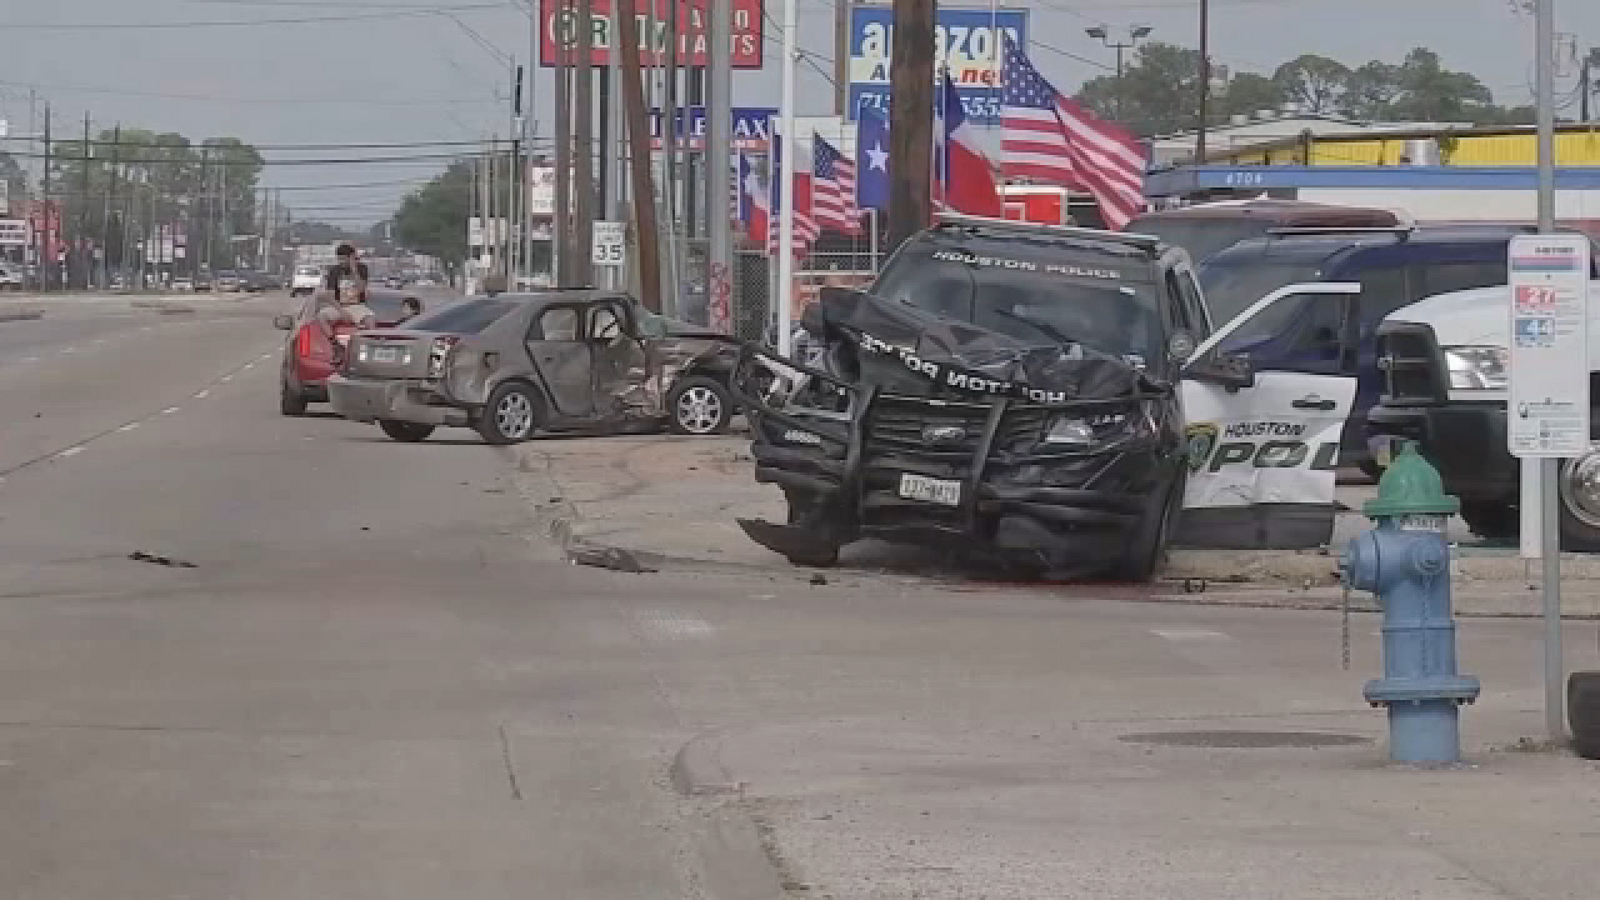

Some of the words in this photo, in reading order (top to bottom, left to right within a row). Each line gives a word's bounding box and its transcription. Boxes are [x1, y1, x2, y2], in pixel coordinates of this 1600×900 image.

[595, 244, 623, 260] 35
[932, 250, 1036, 271] HOUSTON
[1045, 264, 1121, 278] POLICE
[1224, 421, 1307, 438] HOUSTON
